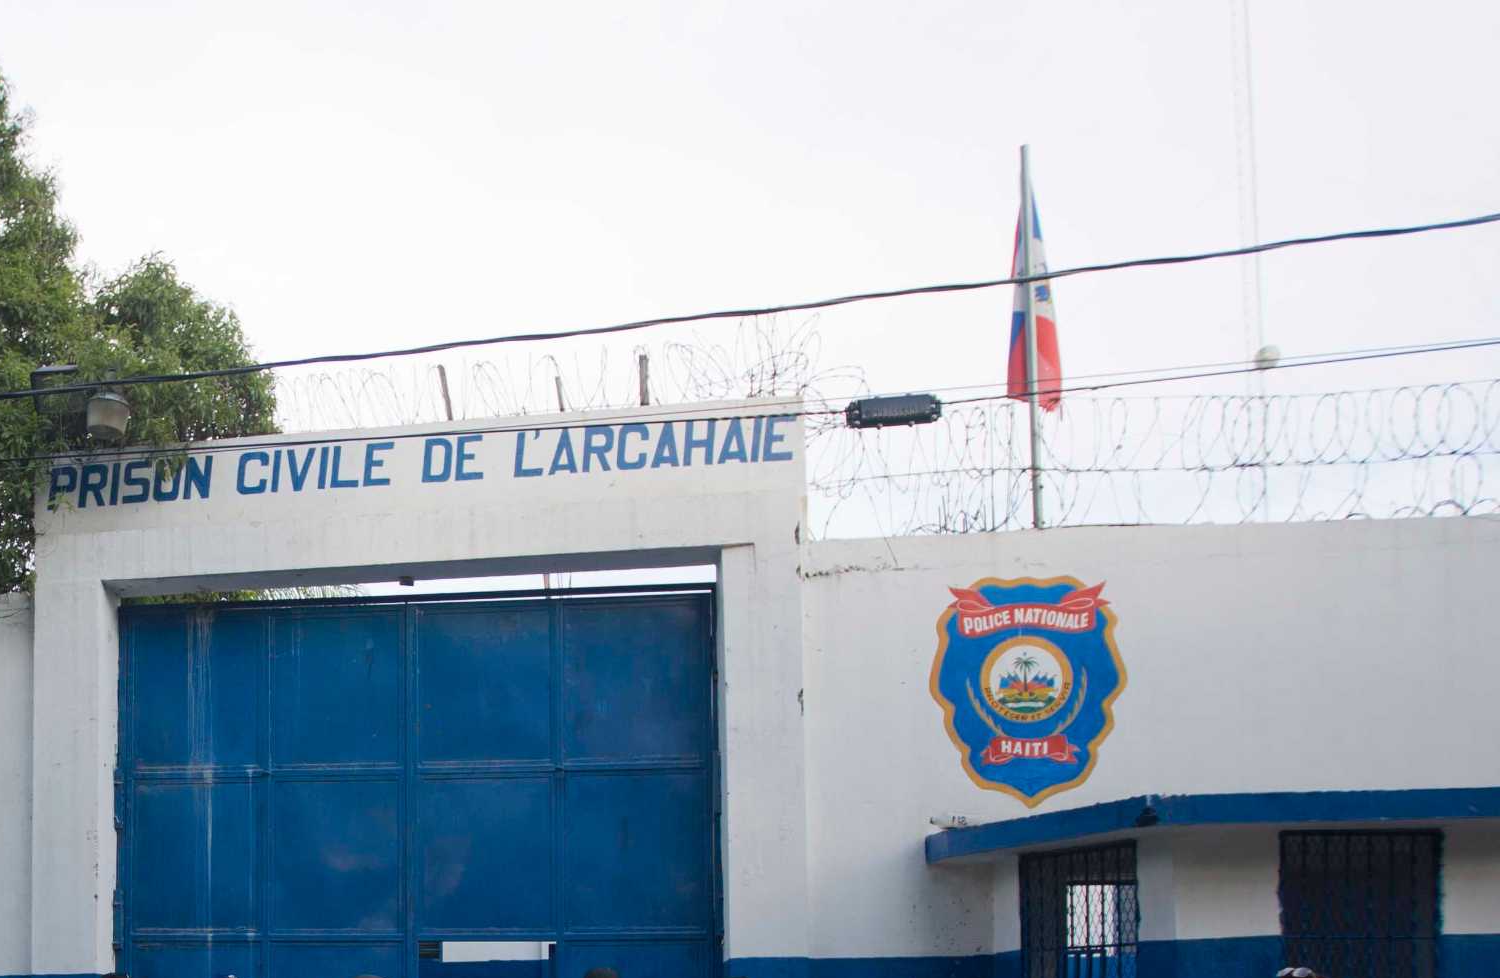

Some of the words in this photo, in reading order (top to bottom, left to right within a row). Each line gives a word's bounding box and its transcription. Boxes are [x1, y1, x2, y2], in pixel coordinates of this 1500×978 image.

[47, 454, 213, 511] PRISON
[235, 440, 396, 496] CIVILE
[421, 434, 484, 483] DE
[513, 414, 798, 478] L'ARCAHAIE
[963, 610, 1011, 634] POLICE
[1014, 607, 1089, 629] NATIONALE
[1001, 740, 1049, 756] HAITI
